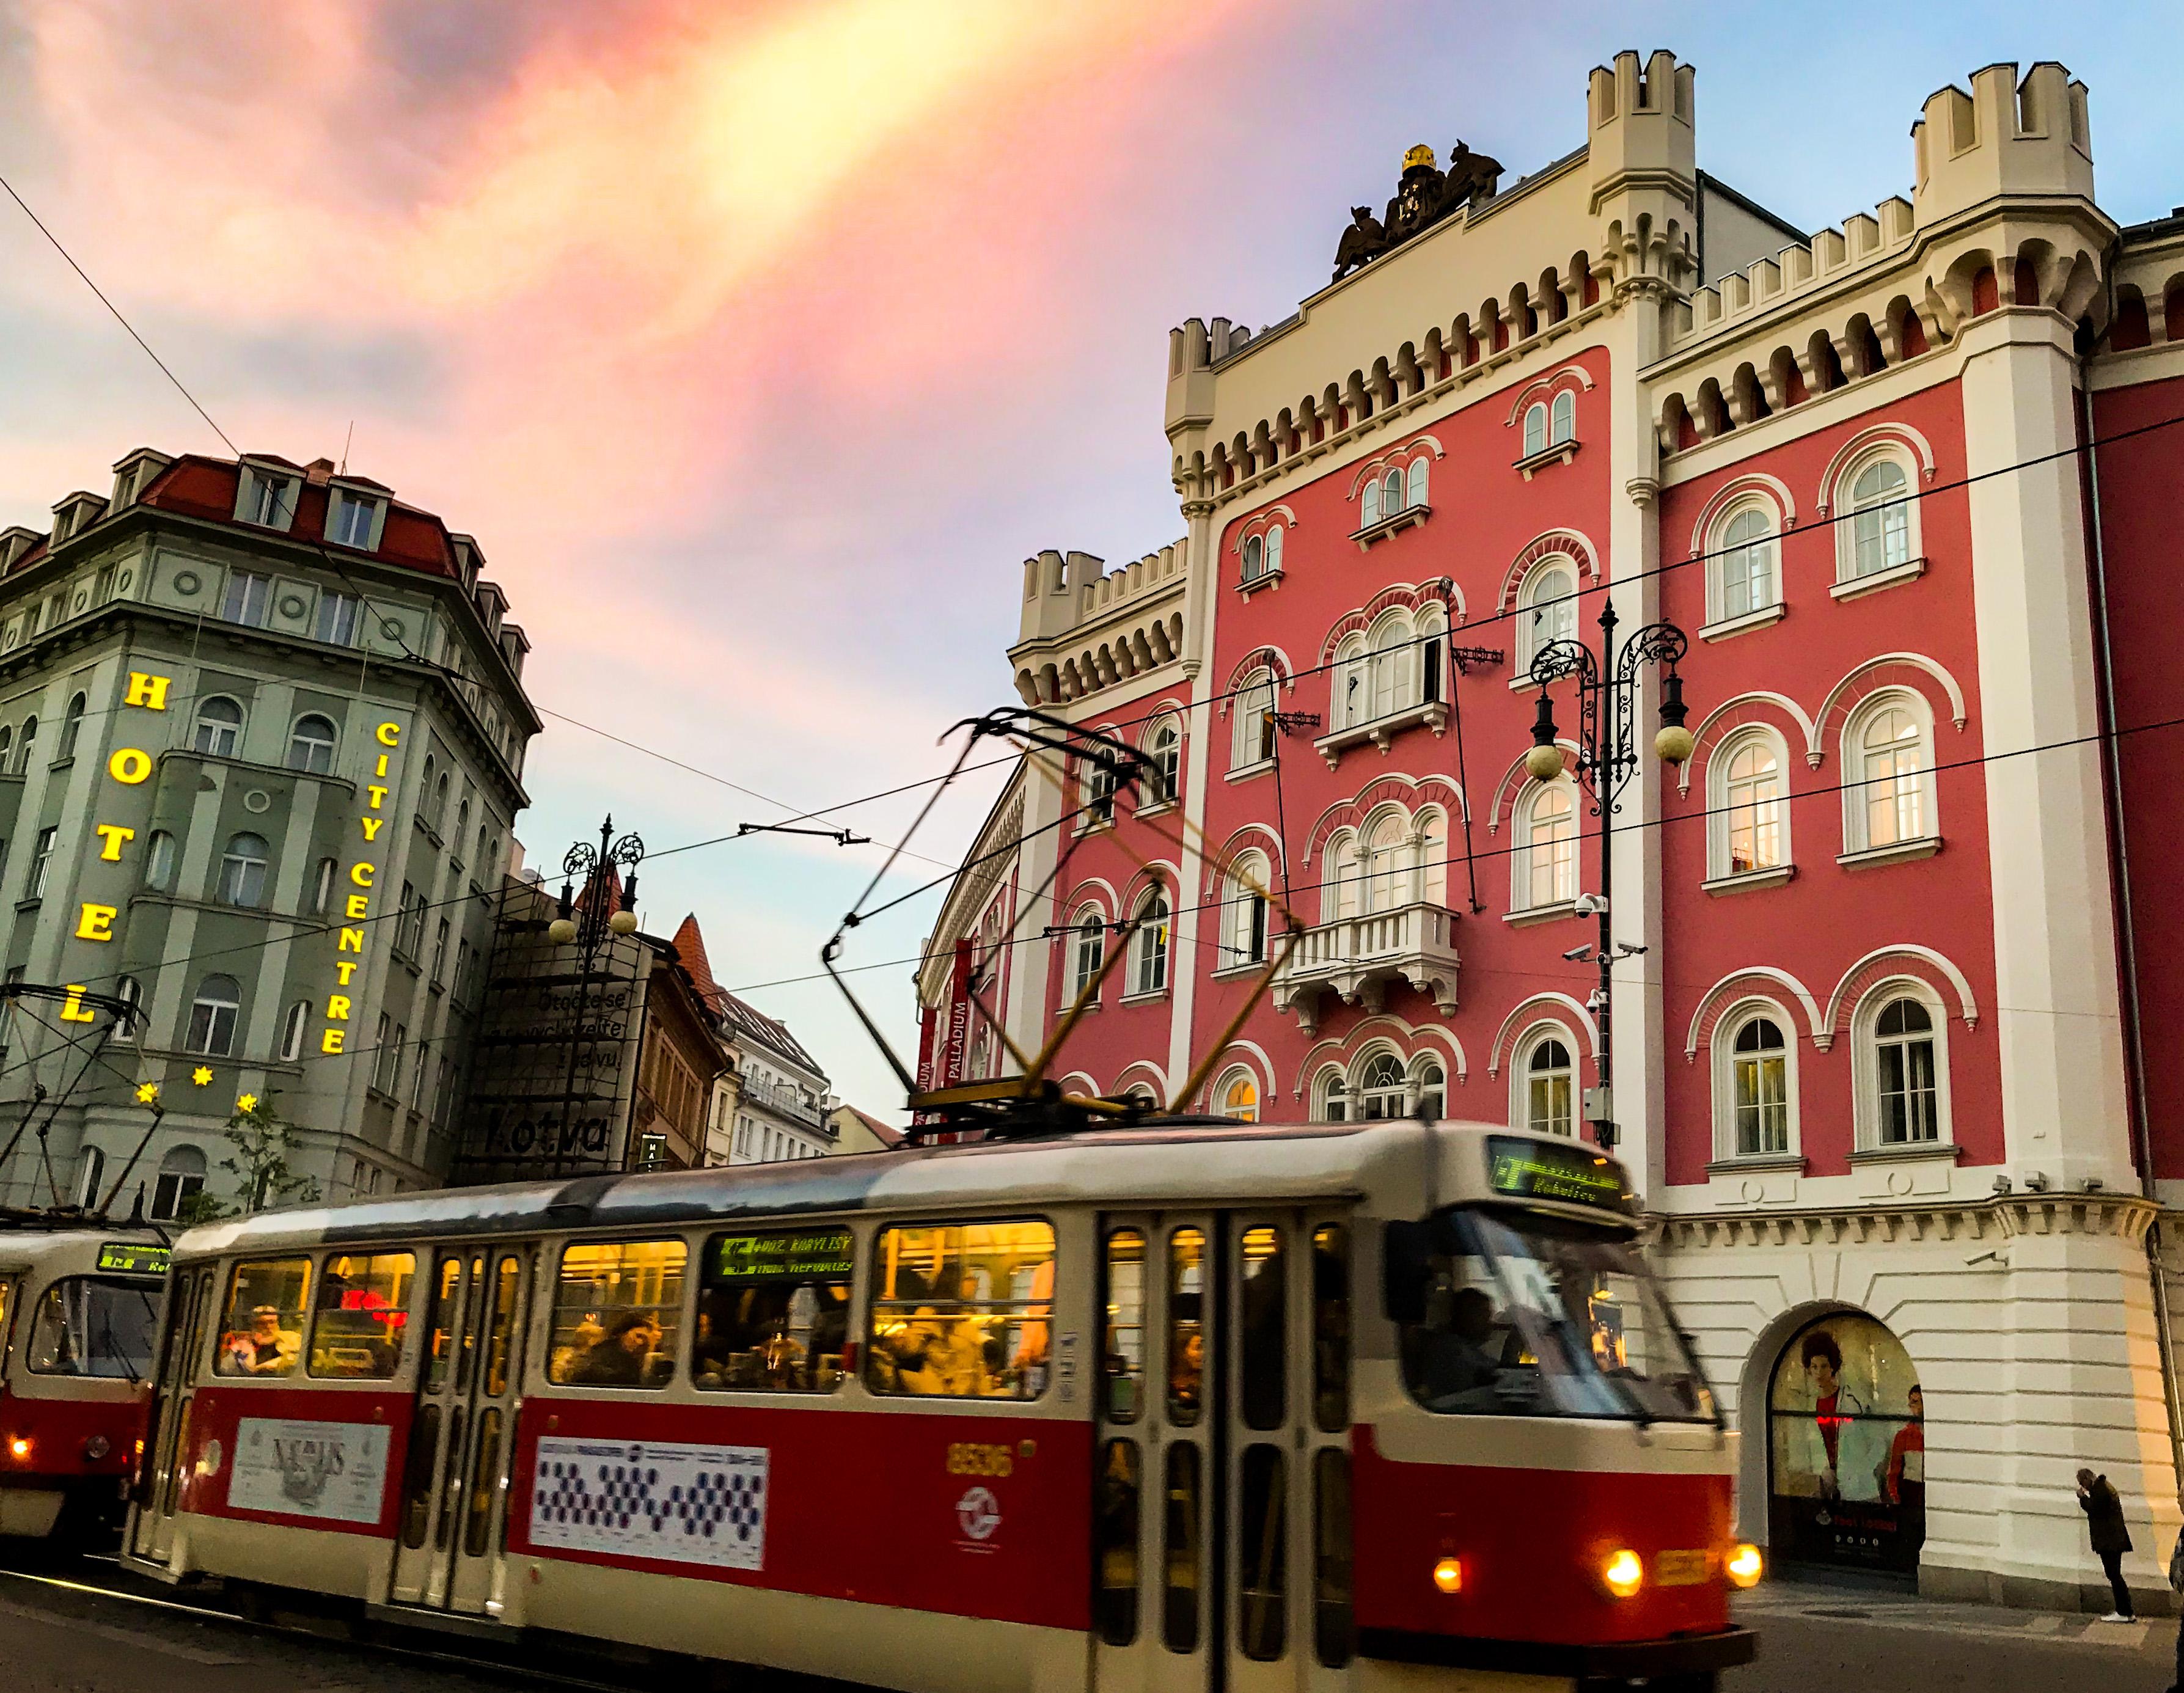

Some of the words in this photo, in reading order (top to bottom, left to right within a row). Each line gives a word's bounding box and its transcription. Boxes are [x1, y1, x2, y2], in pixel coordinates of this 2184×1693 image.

[362, 723, 399, 840] CITY
[60, 673, 170, 1022] HOTEL
[323, 863, 374, 1053] CENTRE
[606, 992, 625, 1007] se
[948, 1002, 966, 1079] PALLADIUM
